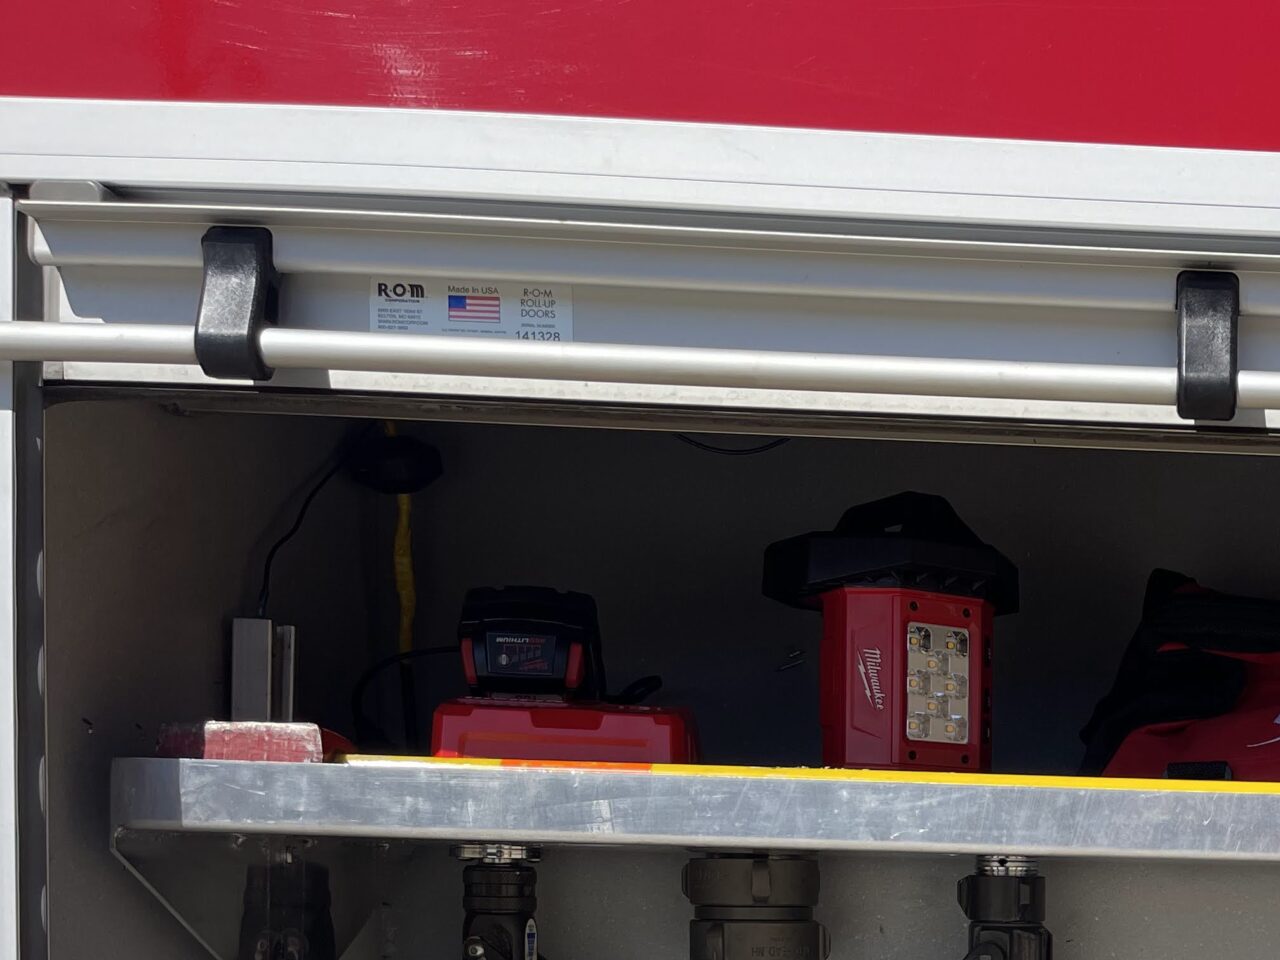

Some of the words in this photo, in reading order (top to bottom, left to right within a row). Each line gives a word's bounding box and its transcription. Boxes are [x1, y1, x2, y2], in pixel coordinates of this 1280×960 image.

[447, 285, 470, 294] Made
[471, 286, 479, 294] In
[481, 286, 499, 295] USA
[520, 308, 556, 319] DOORS
[515, 331, 561, 342] 141328
[863, 647, 886, 711] Milwaukee
